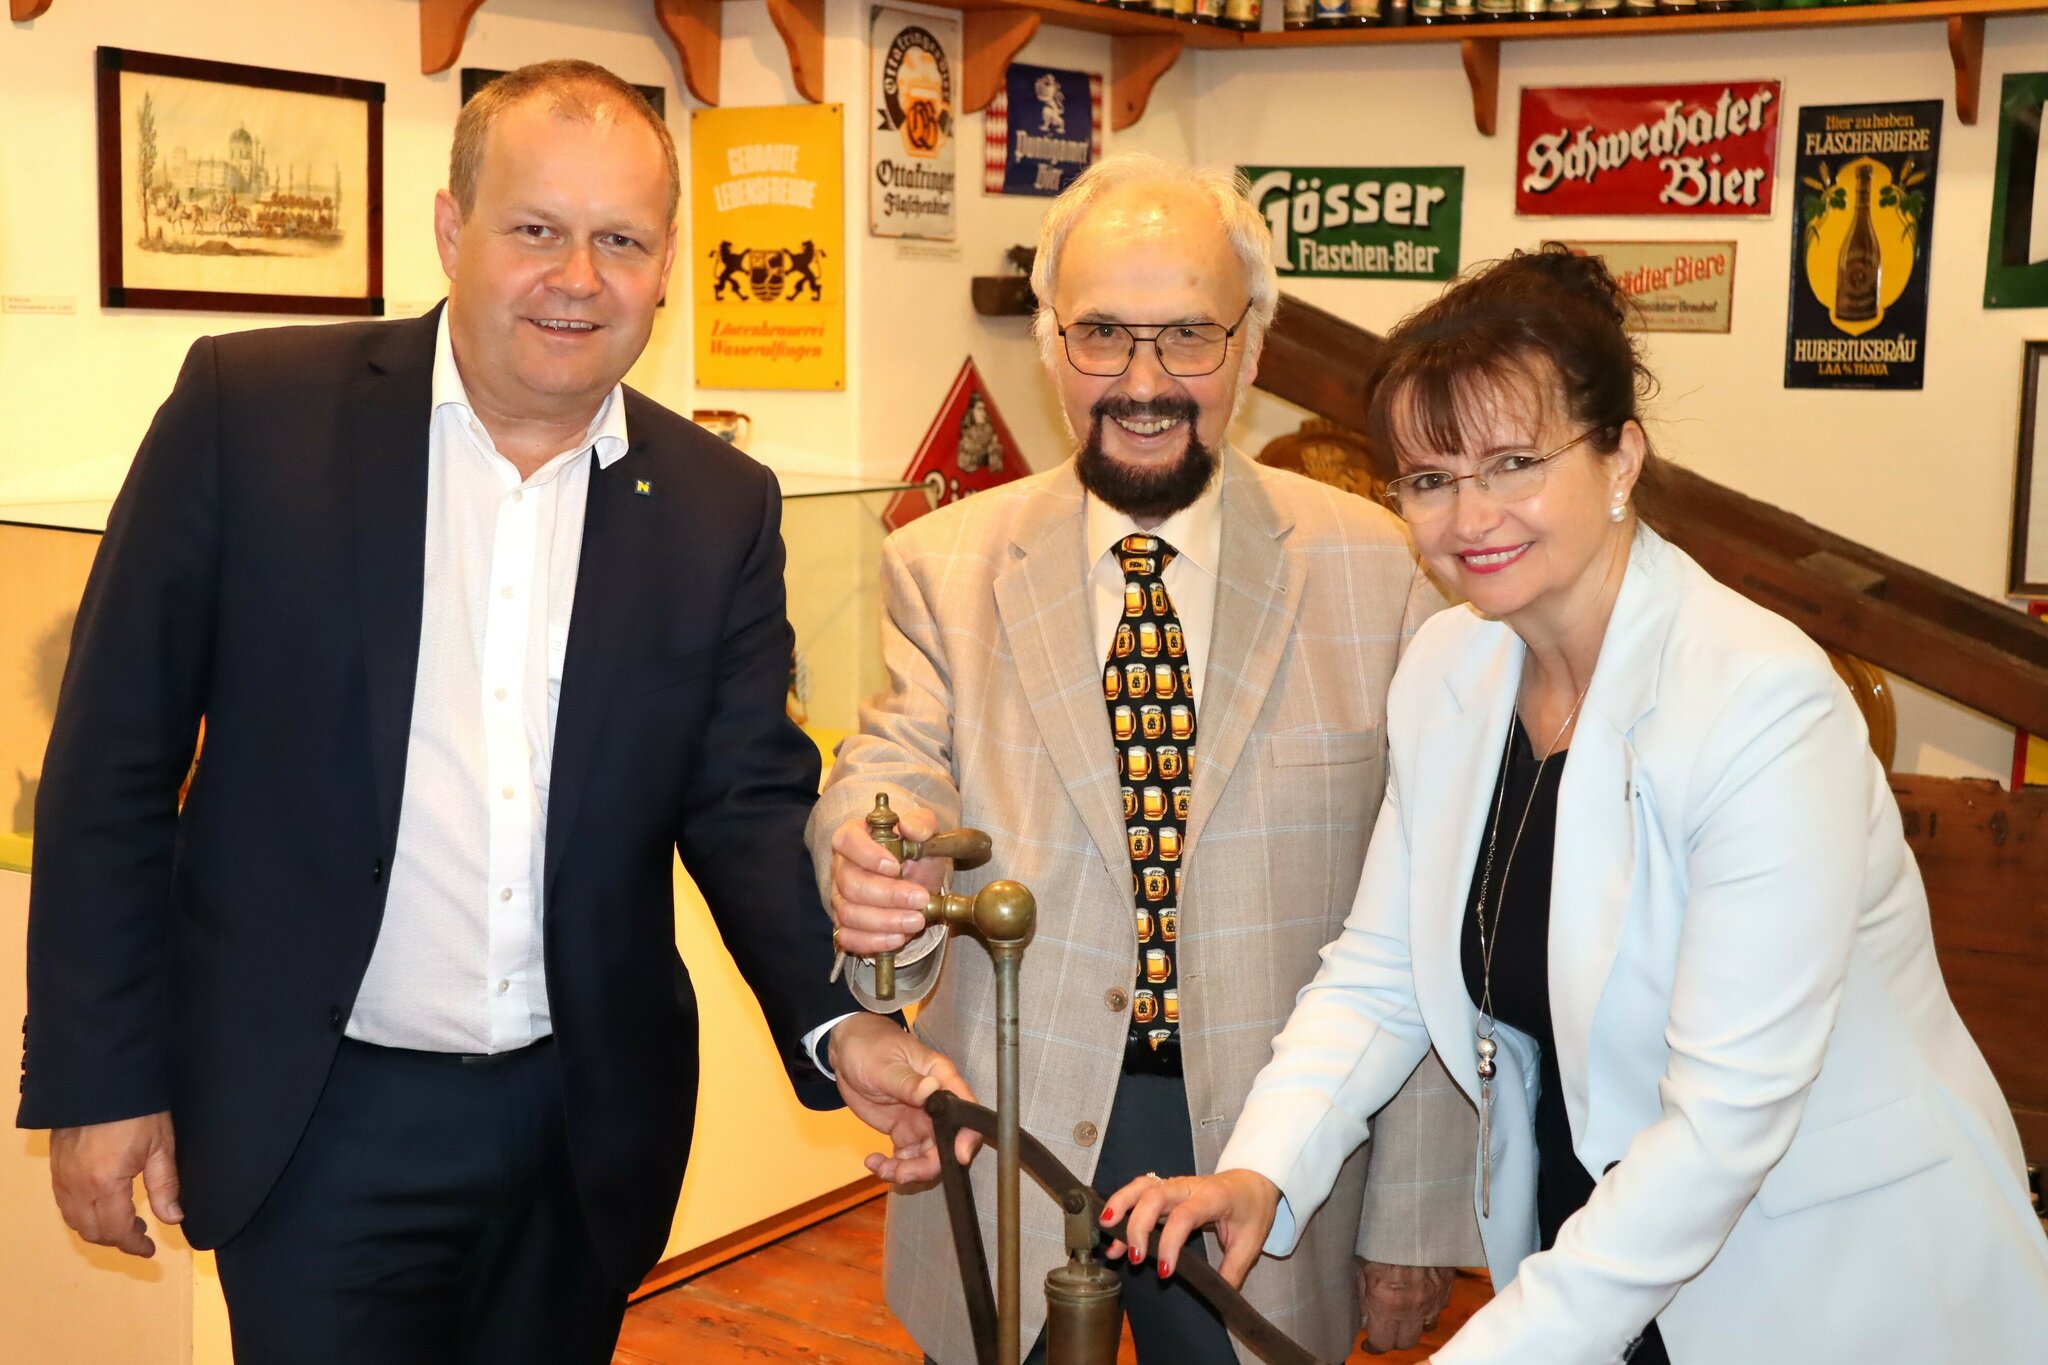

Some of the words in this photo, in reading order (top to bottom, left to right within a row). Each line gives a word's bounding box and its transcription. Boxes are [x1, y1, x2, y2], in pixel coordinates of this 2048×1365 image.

[1826, 114, 1853, 131] Hier
[1855, 116, 1872, 130] zu
[1873, 112, 1914, 129] haben
[1522, 87, 1772, 193] Schwechater
[1805, 128, 1930, 156] FLASCHENBIERE
[727, 143, 799, 177] GEBRAUTE
[712, 176, 818, 212] LEBENSFREUDE
[1659, 152, 1765, 206] Bier
[1250, 170, 1446, 271] Gösser
[1298, 237, 1440, 273] Flaschen-Bier
[1674, 253, 1727, 287] Biere
